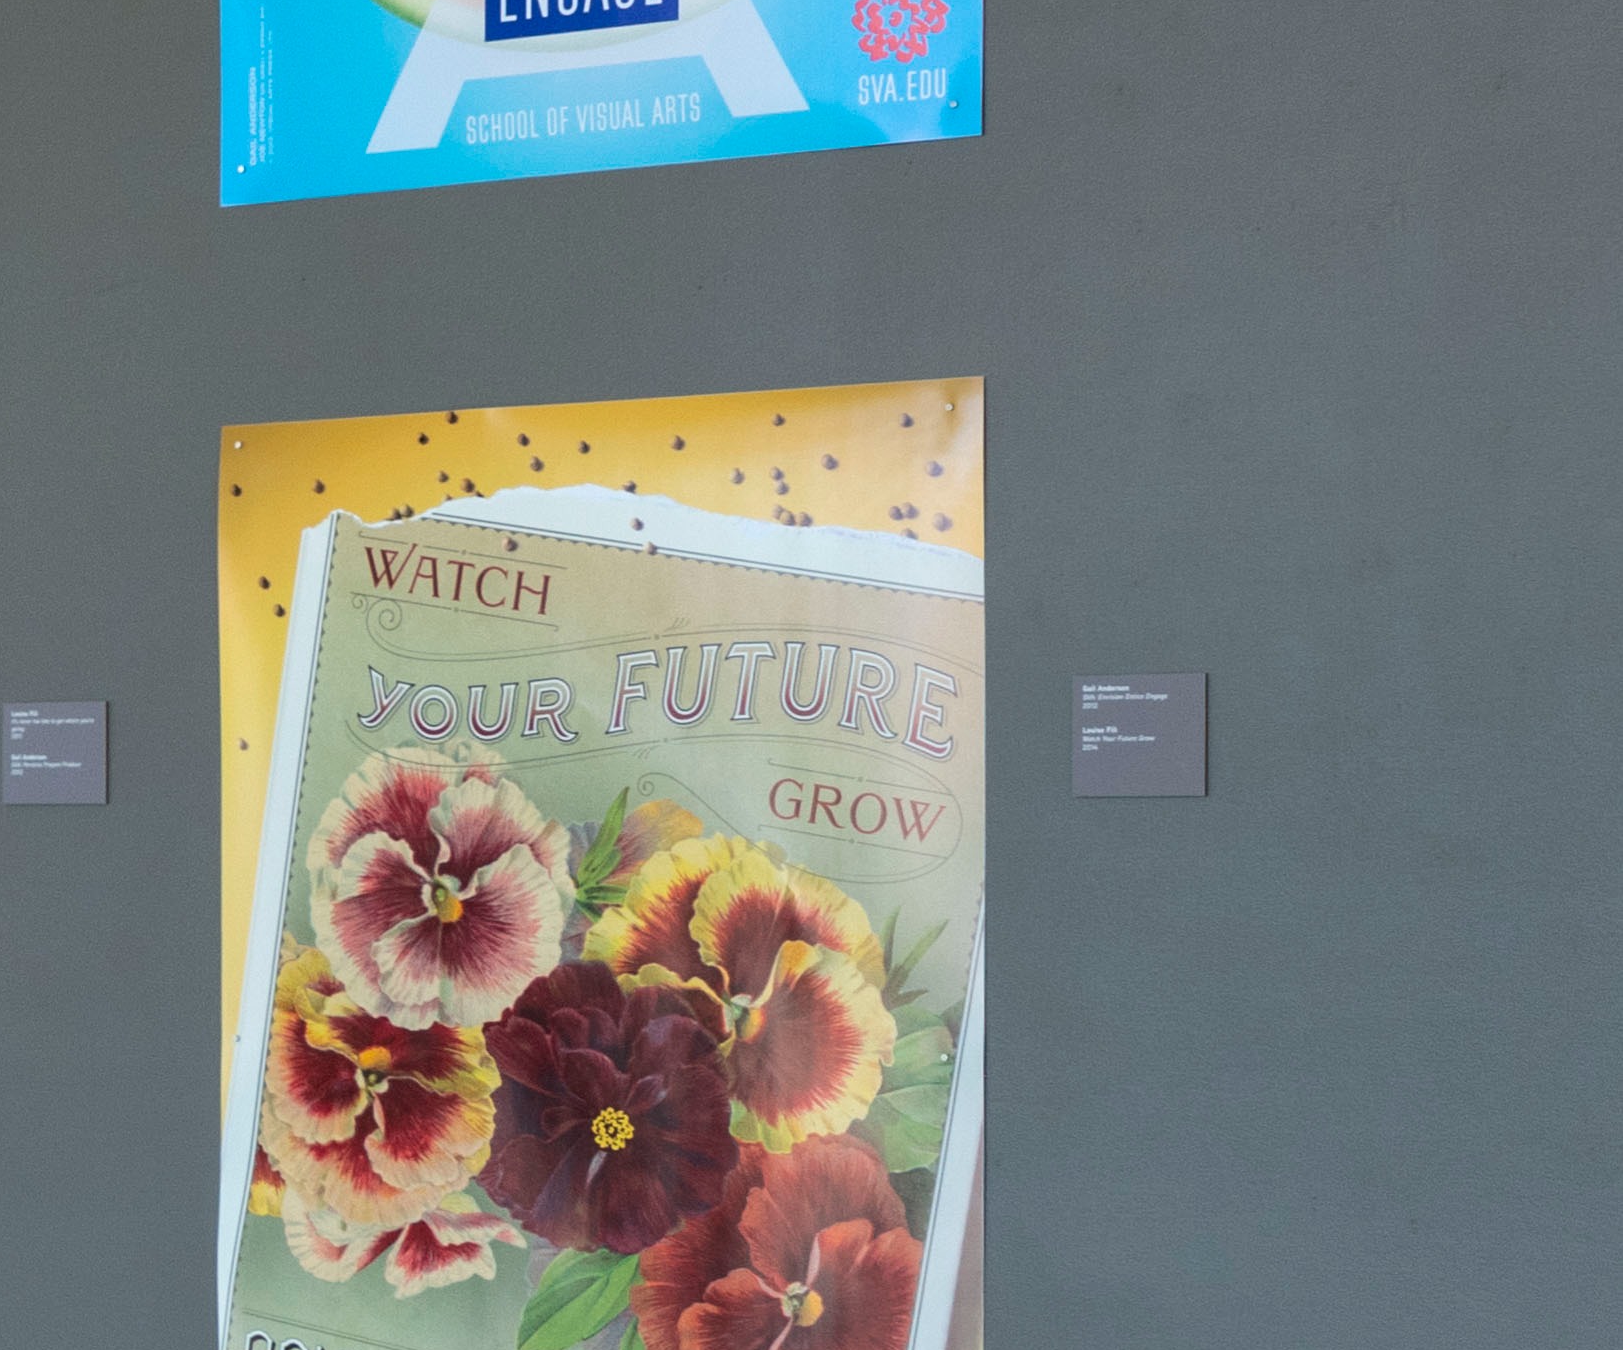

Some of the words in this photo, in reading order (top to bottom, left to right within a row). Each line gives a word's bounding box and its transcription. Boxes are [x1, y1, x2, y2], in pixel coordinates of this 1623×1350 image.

[466, 111, 541, 146] SCHOOL
[548, 107, 570, 136] OF
[577, 98, 645, 133] VISUAL
[650, 93, 702, 128] ARTS
[858, 70, 947, 107] SVA.EDU
[364, 543, 551, 616] WATCH
[358, 665, 579, 744] YOUR
[606, 641, 959, 761] FUTURE
[769, 778, 947, 844] GROW
